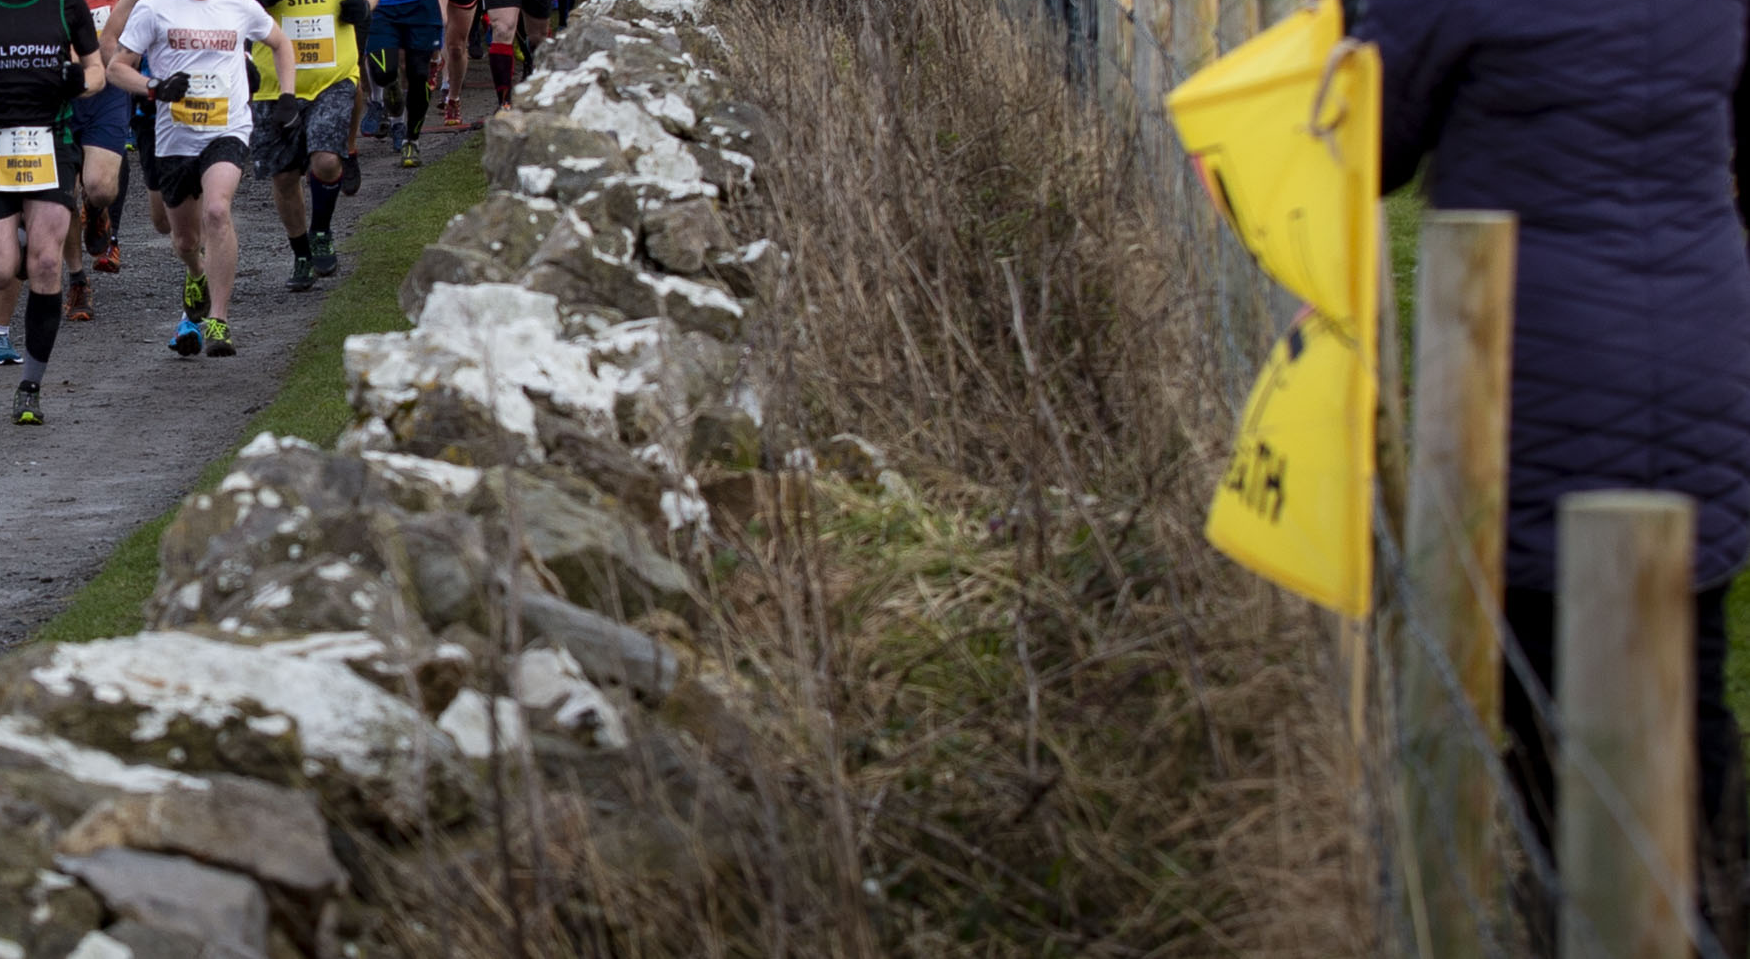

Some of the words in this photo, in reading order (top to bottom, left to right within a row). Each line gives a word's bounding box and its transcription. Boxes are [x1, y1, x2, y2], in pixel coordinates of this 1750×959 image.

[9, 44, 61, 56] POPHAM
[169, 39, 186, 50] DE
[190, 39, 236, 51] CYMRU
[297, 42, 320, 50] Steve
[32, 56, 59, 68] CLUB
[300, 52, 319, 62] 299
[7, 158, 42, 169] Michael
[15, 171, 34, 183] 416
